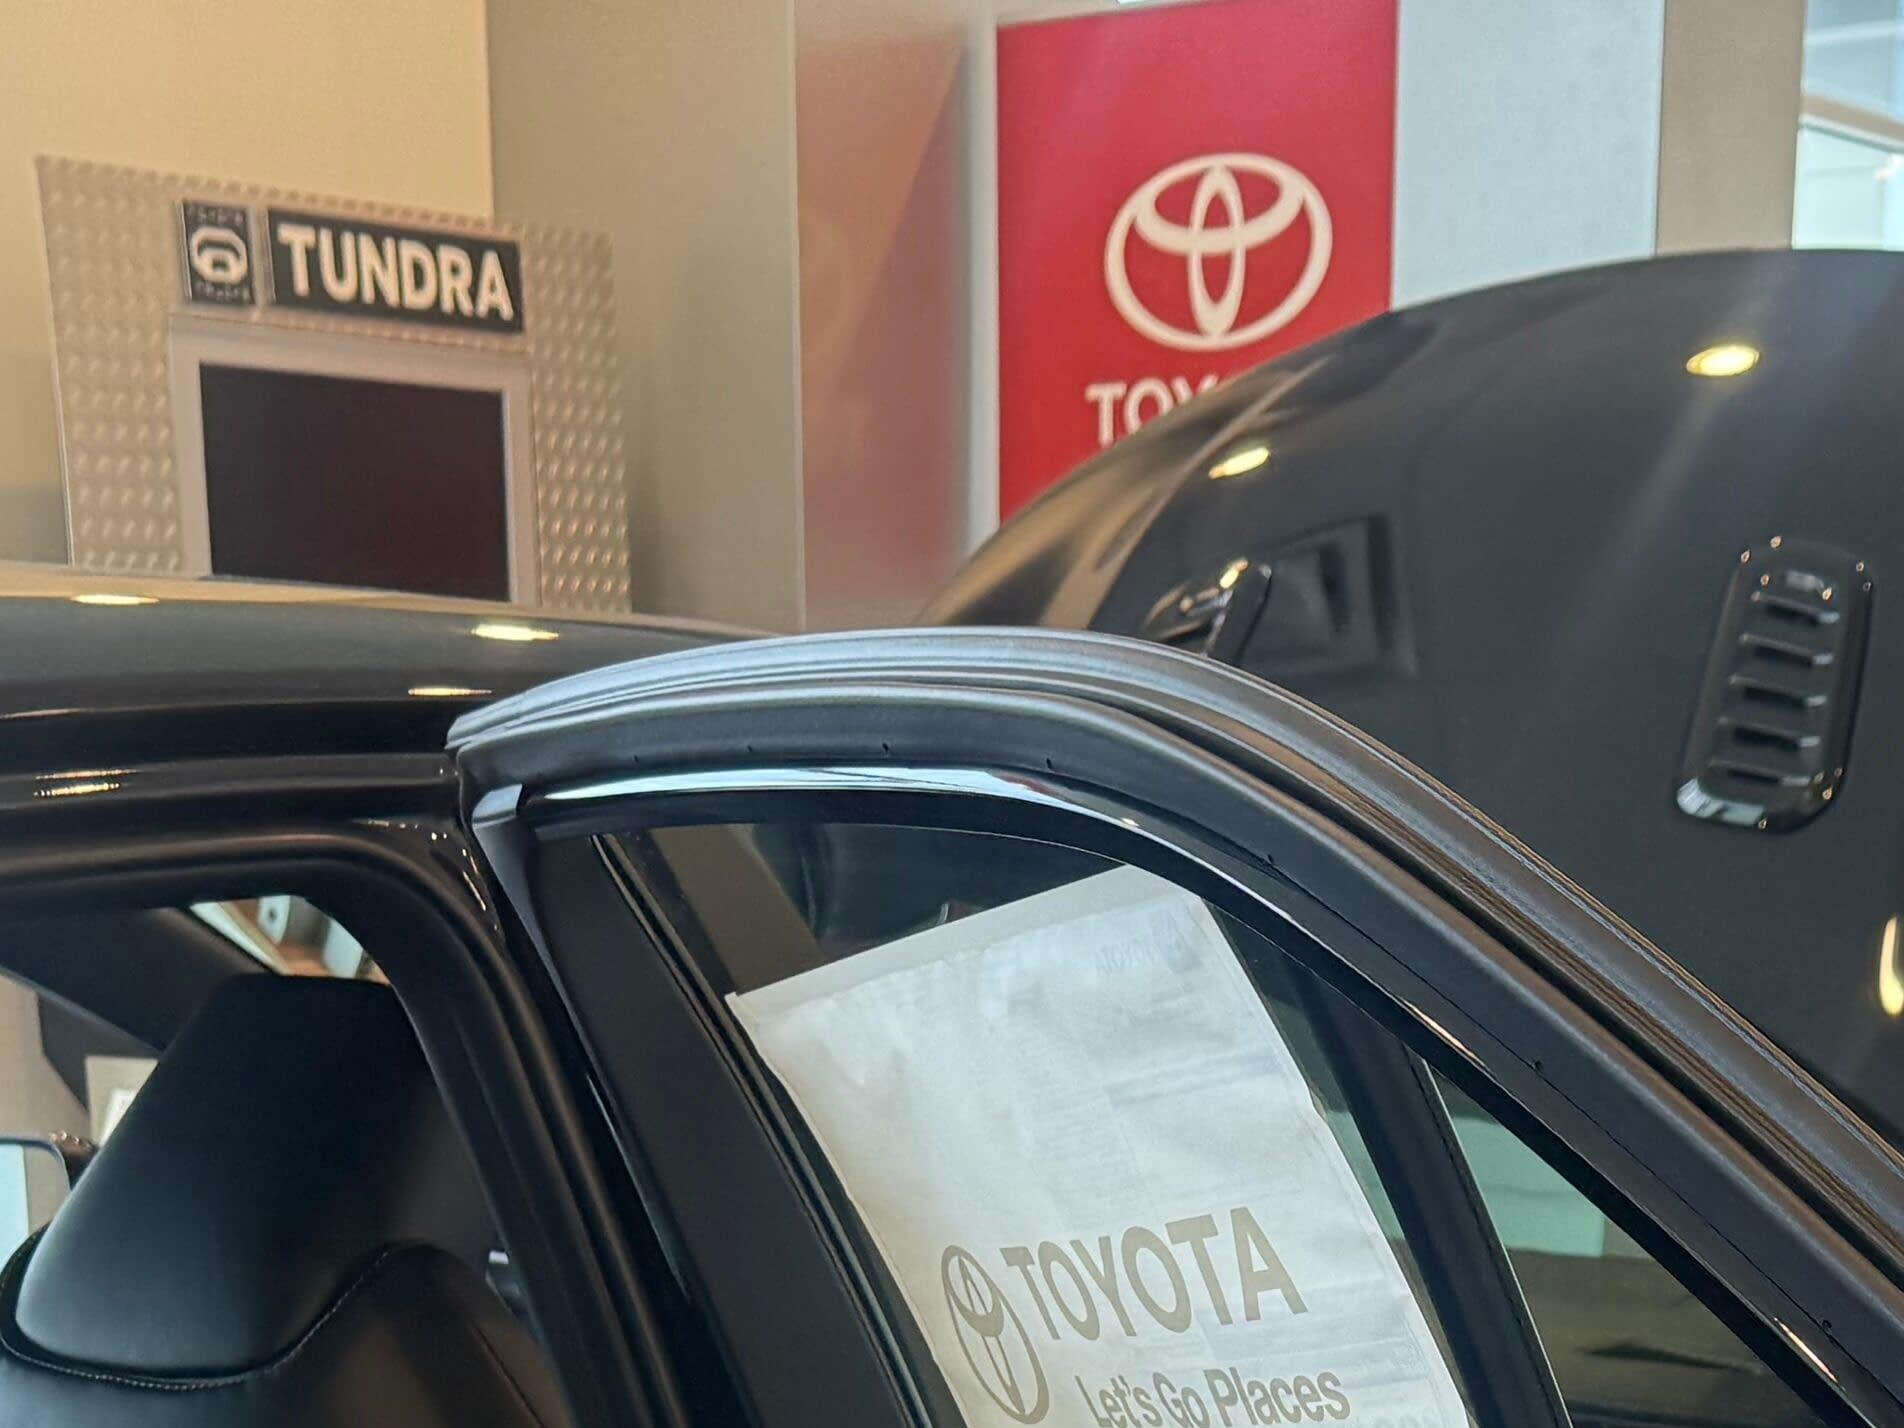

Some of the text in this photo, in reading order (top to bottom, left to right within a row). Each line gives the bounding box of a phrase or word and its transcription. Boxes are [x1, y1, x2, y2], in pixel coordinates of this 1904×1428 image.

[275, 221, 514, 321] TUNDRA
[999, 1206, 1308, 1341] TOYOTA
[1202, 1366, 1351, 1428] Places
